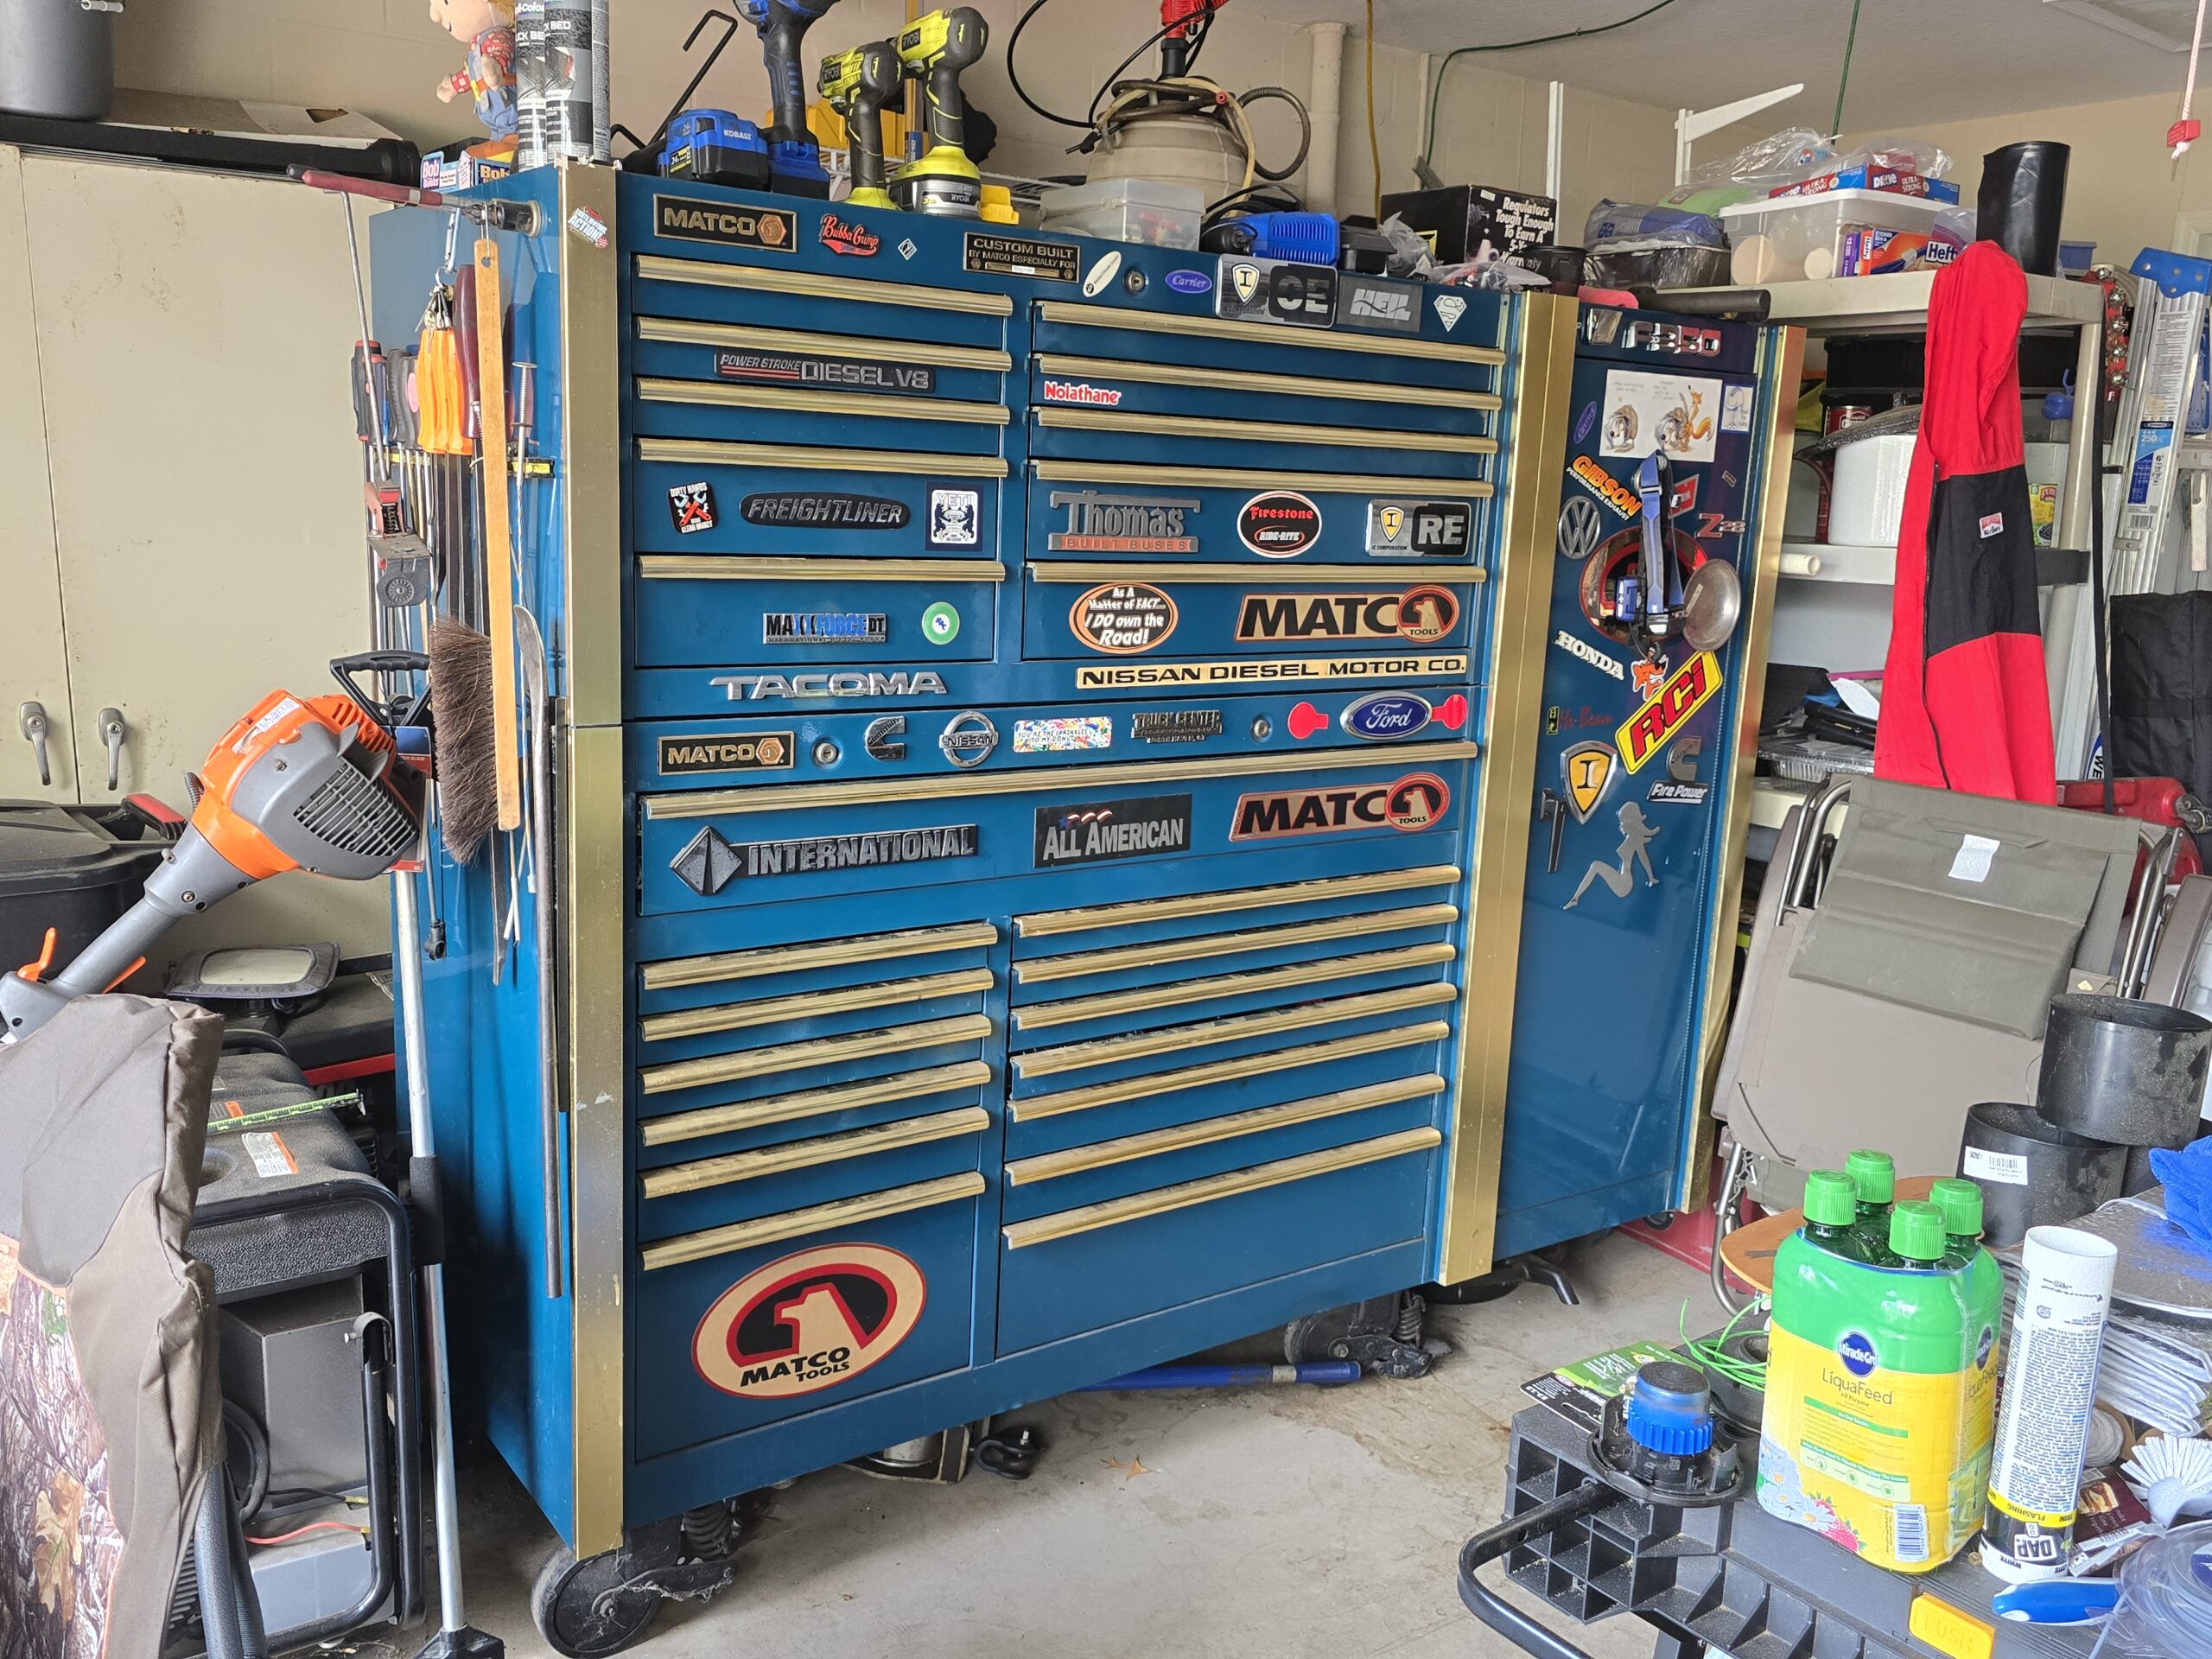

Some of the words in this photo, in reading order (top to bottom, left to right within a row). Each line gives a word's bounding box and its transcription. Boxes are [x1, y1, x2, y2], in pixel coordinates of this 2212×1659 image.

[902, 29, 919, 47] RYOBI
[823, 67, 839, 79] RYOBI
[723, 130, 752, 140] KOBALT
[423, 160, 439, 179] Bob
[951, 194, 969, 203] RYOBI
[1503, 197, 1549, 217] Regulators
[664, 207, 756, 235] MATCO
[1496, 209, 1522, 226] Tough
[1522, 214, 1554, 234] Enough
[820, 213, 852, 240] Bubba
[853, 225, 879, 249] Gump
[1504, 225, 1514, 238] To
[1516, 226, 1535, 242] Earn
[1536, 231, 1544, 243] A
[974, 238, 1033, 254] CUSTOM
[1037, 246, 1073, 258] BUILT
[982, 251, 1010, 262] MATCO
[1012, 254, 1058, 266] ESPECIALLY
[1059, 260, 1076, 269] FOR
[1173, 276, 1206, 289] Carrier
[1350, 288, 1411, 321] HEIL
[721, 353, 760, 369] POWER
[761, 356, 802, 372] STROKE
[802, 361, 895, 387] DIESEL
[896, 368, 929, 390] V8
[1044, 381, 1121, 405] Nolathane
[1567, 467, 1605, 505] PERFORMANCE
[1603, 498, 1630, 521] EXHAUST
[1573, 455, 1643, 517] GIBSON
[937, 493, 974, 507] YETI
[747, 498, 903, 524] FREIGHTLINER
[1051, 489, 1201, 538] Thomas
[1249, 505, 1313, 521] Firestone
[1259, 530, 1303, 543] RIDE-RITE
[1418, 513, 1464, 546] RE
[1065, 537, 1122, 551] BUILT
[1128, 538, 1186, 551] BUSES
[1112, 588, 1124, 599] As
[1126, 587, 1134, 598] A
[1090, 598, 1121, 612] Matter
[1124, 599, 1135, 610] of
[1084, 615, 1092, 627] I
[1094, 613, 1116, 627] DO
[1116, 616, 1141, 627] own
[1144, 613, 1164, 627] the
[1099, 628, 1149, 646] Road!
[1555, 630, 1624, 681] HONDA
[1082, 666, 1202, 687] NISSAN
[1210, 662, 1319, 679] DIESEL
[1329, 659, 1421, 676] MOTOR
[1427, 658, 1465, 673] CO.
[709, 671, 947, 700] TACOMA
[1132, 712, 1174, 729] TRUCK
[1175, 709, 1222, 729] CENTER
[1365, 702, 1412, 728] Ford
[947, 733, 995, 748] NISSAN
[1056, 728, 1089, 737] SPRINKLES
[668, 743, 756, 765] MATCO
[1651, 784, 1675, 797] Fire
[1675, 785, 1707, 799] Power
[1398, 815, 1427, 824] TOOLS
[1043, 826, 1082, 861] ALL
[1085, 817, 1184, 855] AMERICAN
[748, 828, 974, 875] INTERNATIONAL
[741, 1346, 851, 1387] MATCO
[796, 1360, 850, 1382] TOOLS
[1822, 1367, 1893, 1405] LiquaFeed
[1849, 1395, 1870, 1408] Purpose
[2007, 1503, 2045, 1522] FLASHING
[2089, 1516, 2103, 1534] togeth
[1999, 1555, 2022, 1569] WHITE
